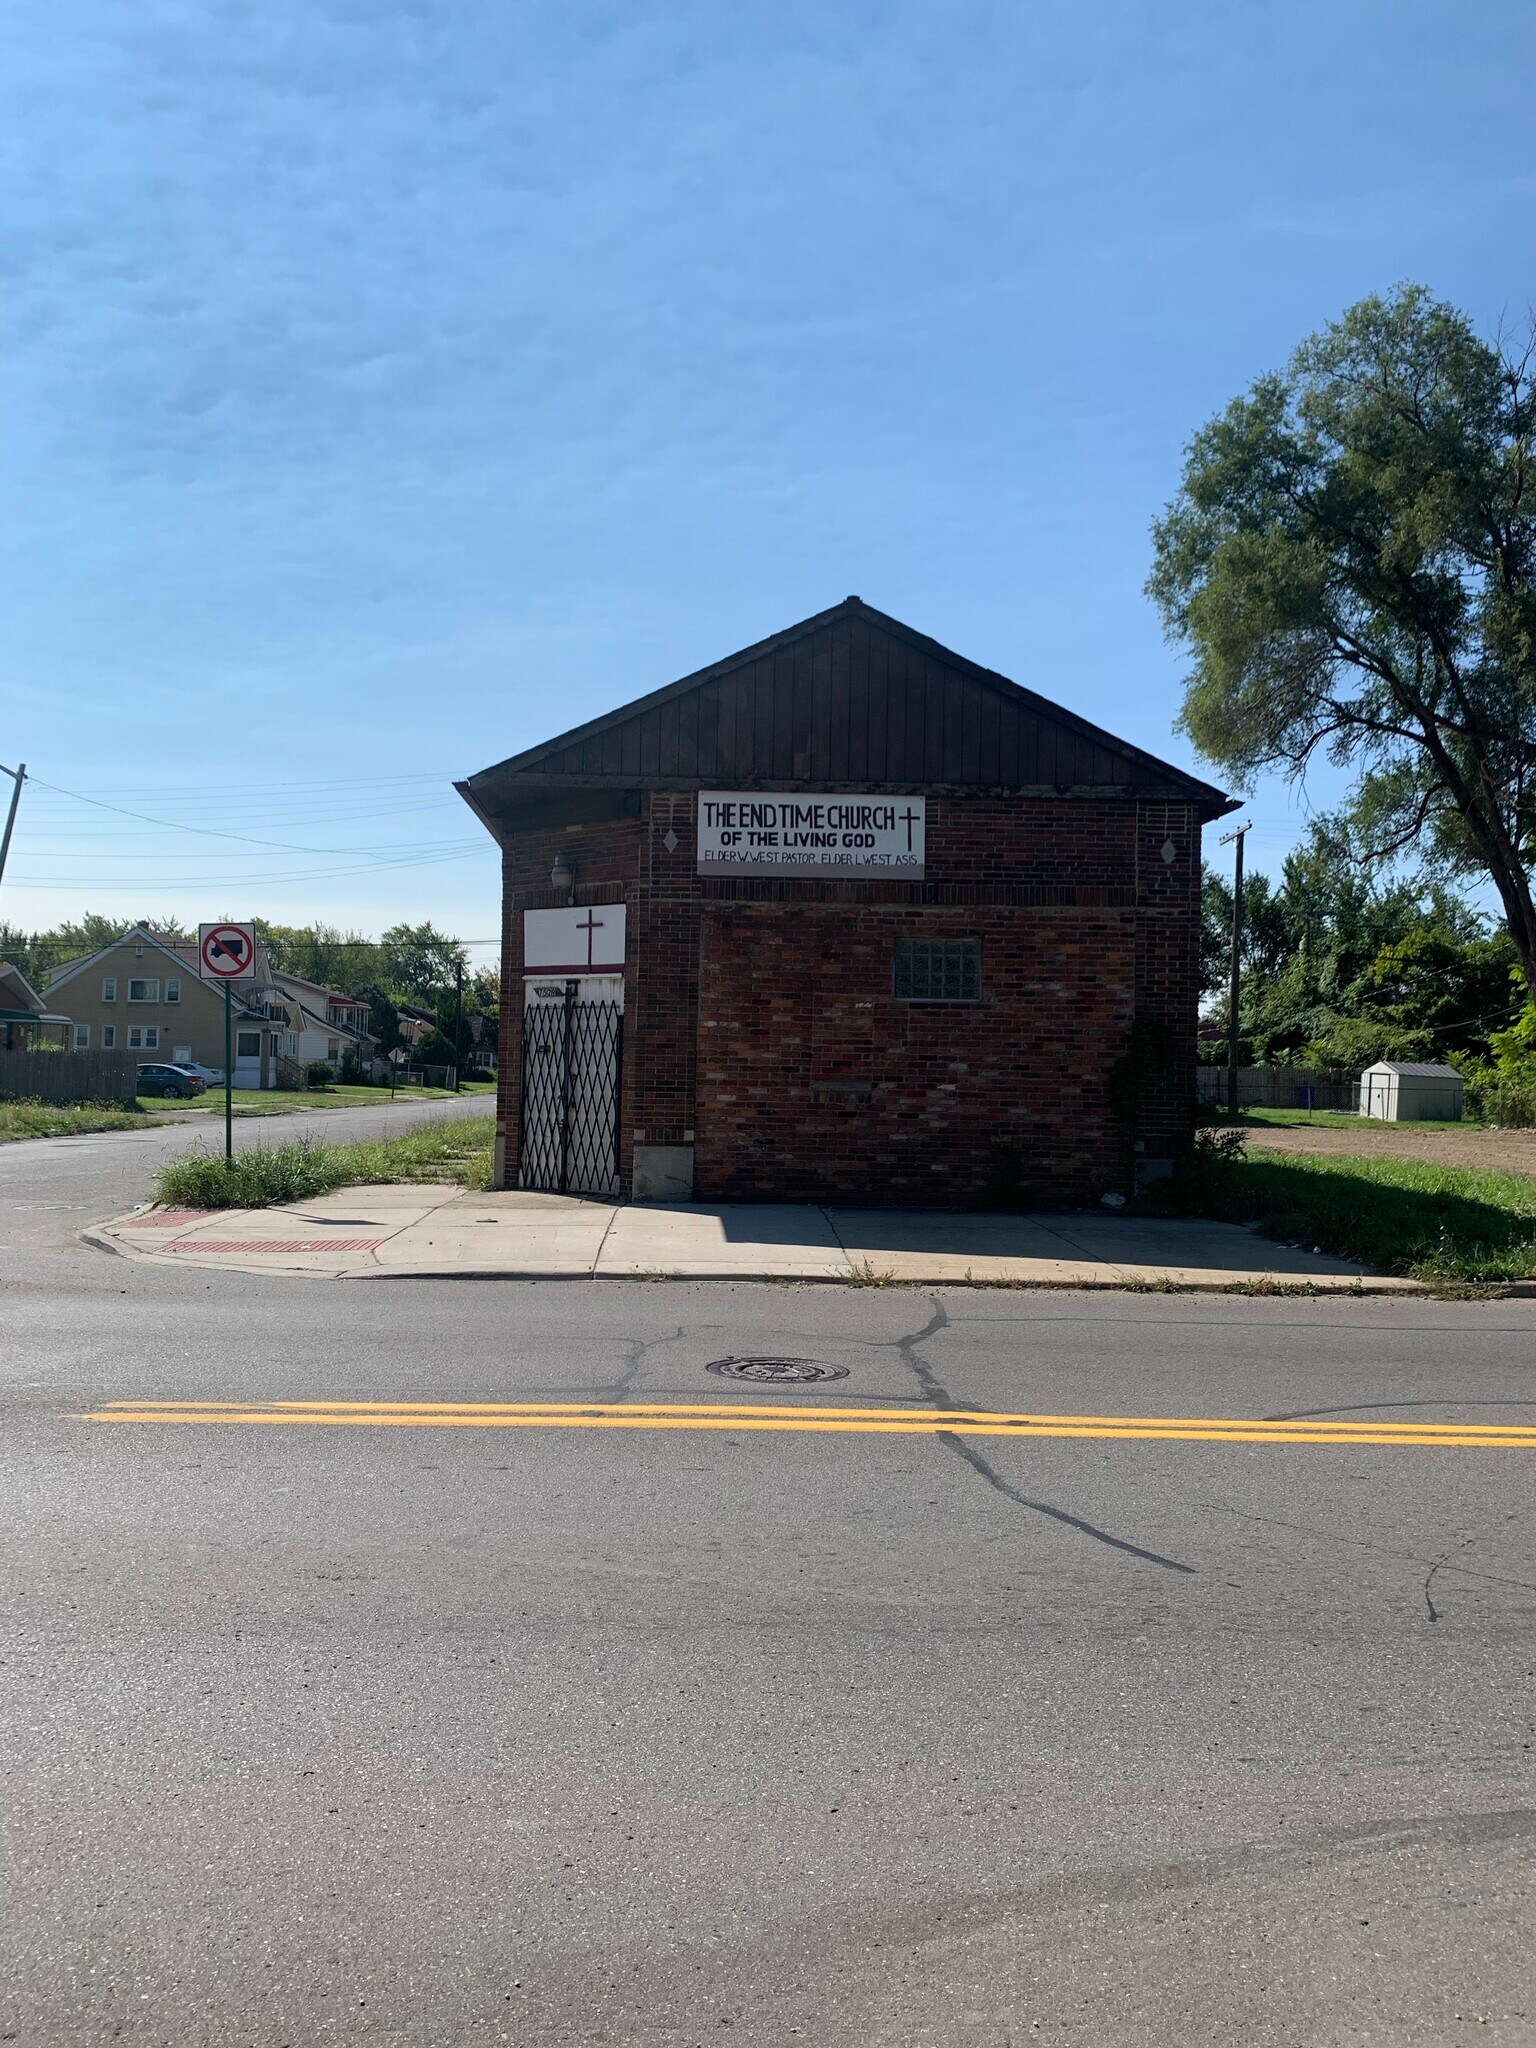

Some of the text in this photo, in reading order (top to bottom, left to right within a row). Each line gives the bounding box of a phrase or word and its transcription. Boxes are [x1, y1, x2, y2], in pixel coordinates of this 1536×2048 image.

[703, 803, 895, 831] THE END TIME CHURCH
[720, 831, 875, 848] OF THE LIVING GOD
[704, 850, 737, 862] ELDER
[750, 851, 779, 864] WEST
[821, 853, 853, 865] ELDER
[862, 853, 892, 866] WEST
